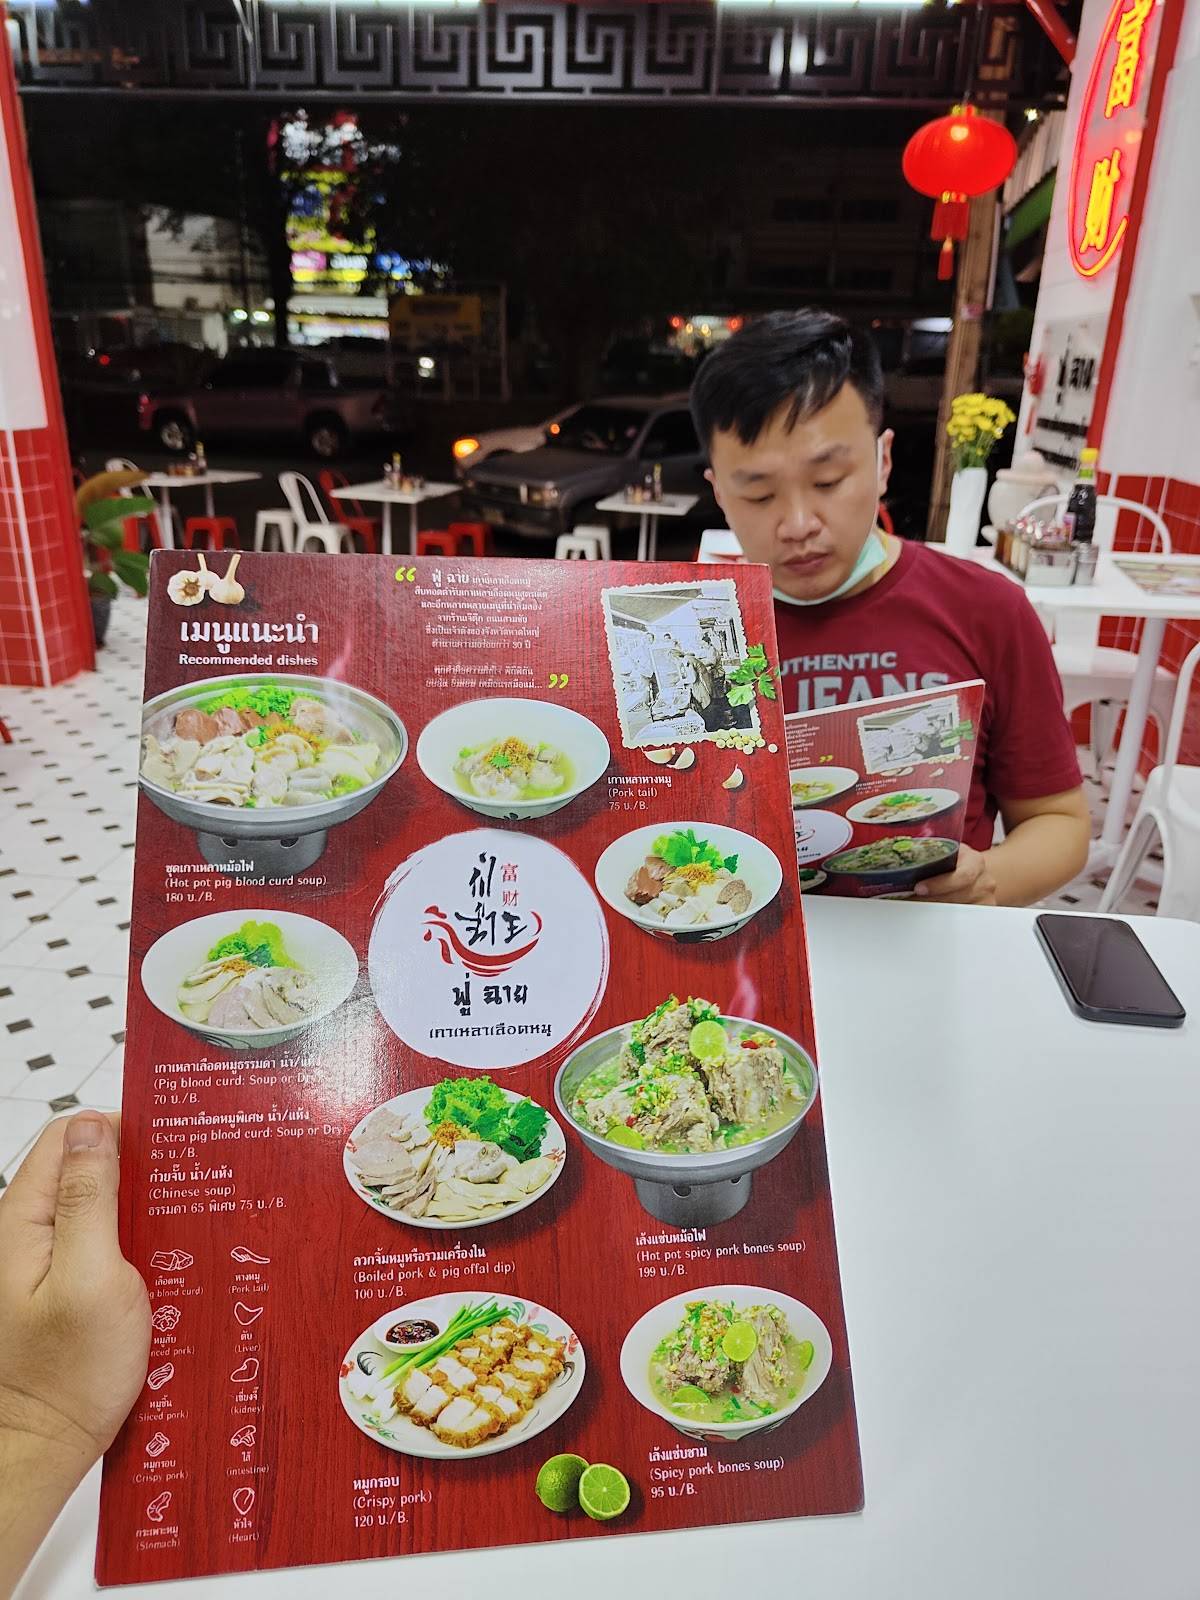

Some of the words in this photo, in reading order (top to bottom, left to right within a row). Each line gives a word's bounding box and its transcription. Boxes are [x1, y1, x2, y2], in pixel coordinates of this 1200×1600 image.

[432, 568, 442, 588] ฟู่
[180, 614, 319, 653] เมนูแนะนำ
[179, 653, 273, 666] Recommended
[277, 654, 319, 666] dishes
[781, 651, 897, 676] UTHENTIC
[608, 775, 672, 788] เกาเหลาหางหมู
[608, 787, 634, 798] (Pork
[637, 787, 658, 798] tail)
[608, 801, 620, 811] 75
[165, 859, 254, 878] ชุดเกาเหลาหม้อไฟ
[165, 877, 190, 889] (Hot
[193, 878, 211, 890] pot
[214, 877, 232, 889] pig
[235, 875, 266, 887] blood
[268, 875, 294, 886] curd
[297, 875, 327, 887] soup)
[165, 892, 184, 903] 180
[452, 972, 471, 1016] ฟู่
[429, 1022, 552, 1039] เกาเหลาเลือดหมู
[154, 1058, 276, 1075] เกาเหลาเลือดหมูธรรมดา
[154, 1078, 177, 1091] (Pig
[181, 1076, 212, 1088] blood
[215, 1076, 245, 1088] curd:
[249, 1074, 277, 1086] Soup
[281, 1075, 293, 1084] or
[154, 1094, 168, 1105] 70
[152, 1110, 264, 1130] เกาเหลาเลือดหมูพิเศษ
[151, 1132, 185, 1145] (Extra
[189, 1132, 207, 1144] pig
[210, 1128, 241, 1141] blood
[244, 1128, 273, 1139] curd:
[276, 1126, 304, 1138] Soup
[307, 1127, 319, 1136] or
[150, 1149, 164, 1160] 85
[150, 1164, 186, 1183] ก๋วยจั๊บ
[190, 1162, 233, 1181] น้ำ/แห้ง
[148, 1187, 200, 1200] (Chinese
[204, 1184, 236, 1197] soup)
[148, 1203, 187, 1216] ธรรมดา
[191, 1202, 204, 1214] 65
[209, 1199, 236, 1213] พิเศษ
[240, 1199, 253, 1210] 75
[636, 1227, 706, 1246] เล้งแซ่บหม้อไฟ
[353, 1241, 486, 1268] ลวกจิ้มหมูหรือรวมเครื่องใน
[636, 1250, 661, 1263] (Hot
[664, 1249, 682, 1262] pot
[685, 1246, 712, 1259] spicy
[716, 1243, 740, 1257] pork
[743, 1242, 775, 1254] bones
[777, 1239, 806, 1252] soup)
[353, 1269, 394, 1284] (Boiled
[398, 1267, 424, 1283] pork
[428, 1267, 437, 1278] &
[442, 1266, 460, 1279] pig
[463, 1262, 489, 1276] offal
[493, 1261, 516, 1274] dip)
[638, 1266, 656, 1278] 199
[155, 1275, 185, 1288] เลือดหมู
[157, 1288, 179, 1298] blood
[182, 1286, 204, 1296] curd)
[354, 1288, 373, 1300] 100
[234, 1344, 261, 1354] (Liver)
[166, 1409, 189, 1421] pork)
[230, 1404, 265, 1416] (kidney)
[649, 1444, 708, 1462] เล้งแซ่บชาม
[143, 1459, 176, 1473] หมูกรอบ
[650, 1466, 684, 1481] (Spicy
[688, 1462, 714, 1478] pork
[718, 1461, 751, 1474] bones
[754, 1455, 784, 1471] soup)
[353, 1476, 400, 1495] หมูกรอบ
[651, 1486, 664, 1498] 95
[353, 1494, 395, 1510] (Crispy
[401, 1489, 432, 1507] pork)
[354, 1515, 374, 1528] 120
[228, 1532, 260, 1544] (Heart)
